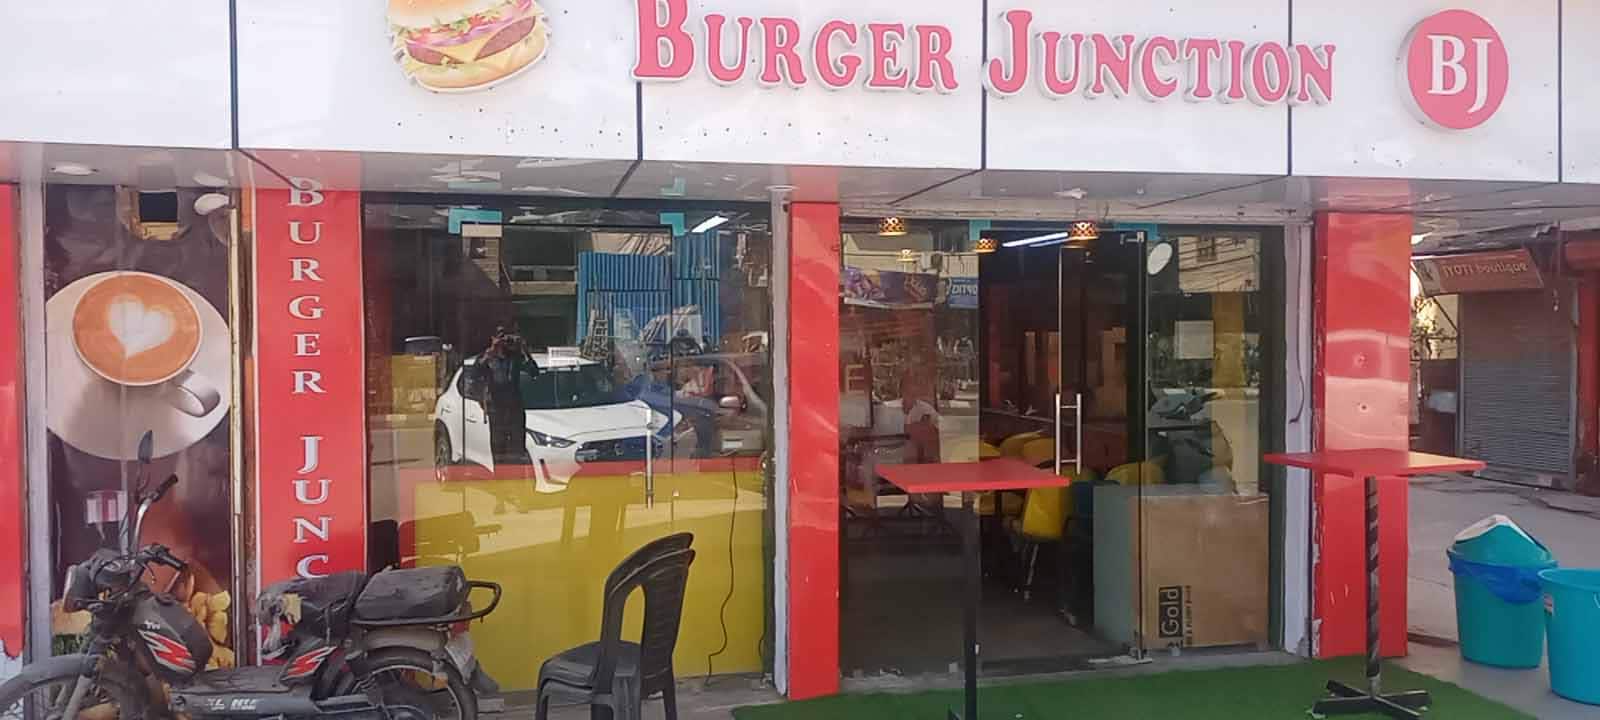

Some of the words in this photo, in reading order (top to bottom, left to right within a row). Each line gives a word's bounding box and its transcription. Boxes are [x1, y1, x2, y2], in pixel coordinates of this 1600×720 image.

[632, 0, 959, 95] BURGER
[983, 8, 1337, 106] JUNCTION
[1426, 33, 1493, 114] BJ
[287, 180, 326, 394] BURGER
[1160, 589, 1180, 635] Gold
